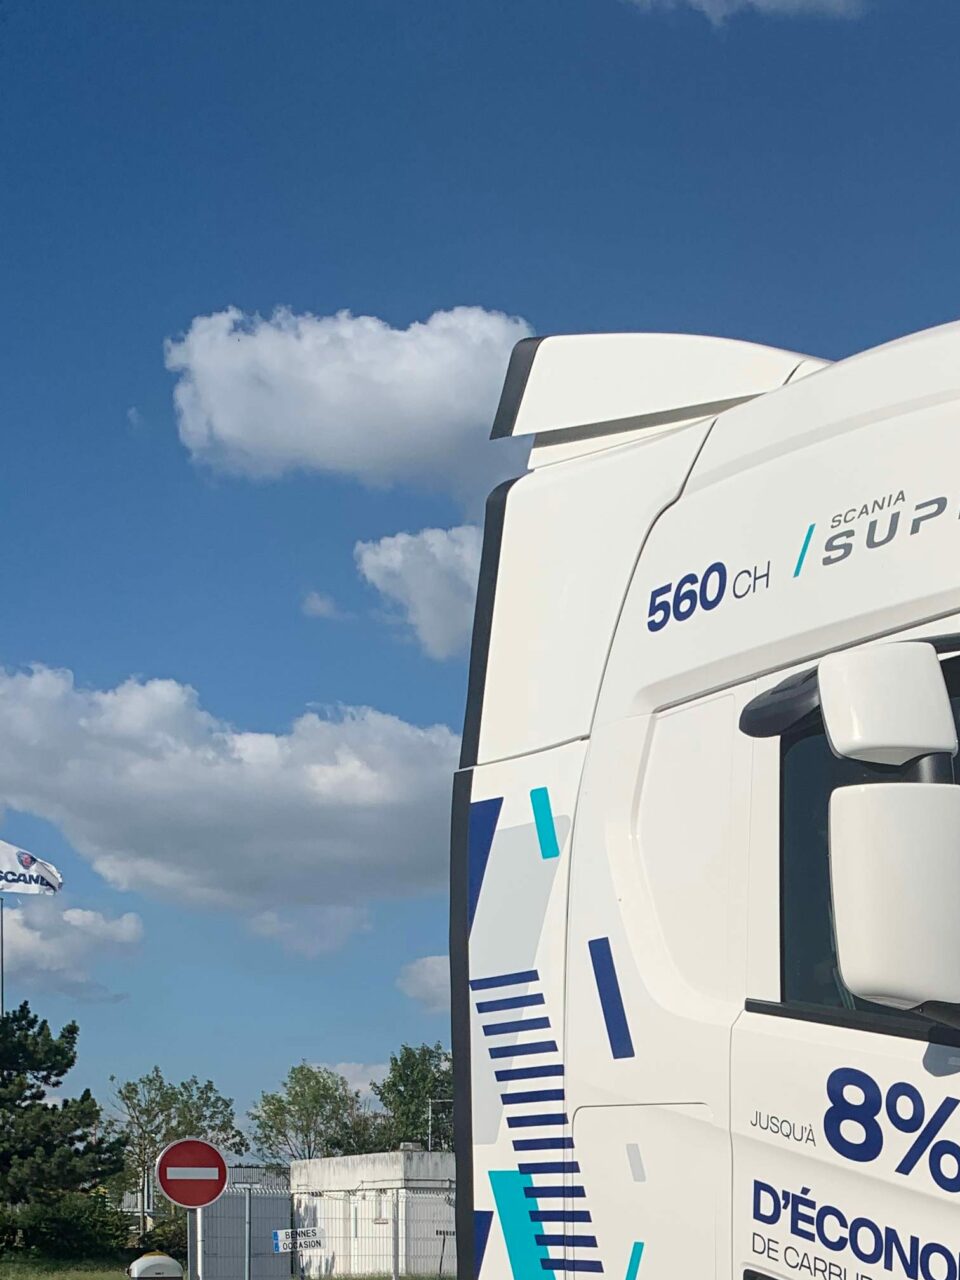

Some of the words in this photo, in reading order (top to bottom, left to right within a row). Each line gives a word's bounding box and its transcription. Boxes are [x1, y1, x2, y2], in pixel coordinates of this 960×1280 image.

[830, 490, 906, 529] SCANIA
[647, 562, 728, 633] 560
[732, 560, 771, 599] CH
[750, 1110, 817, 1147] JUSQU'À
[283, 1240, 321, 1250] OCCASION
[285, 1229, 316, 1239] BENNES
[752, 1232, 779, 1261] DE
